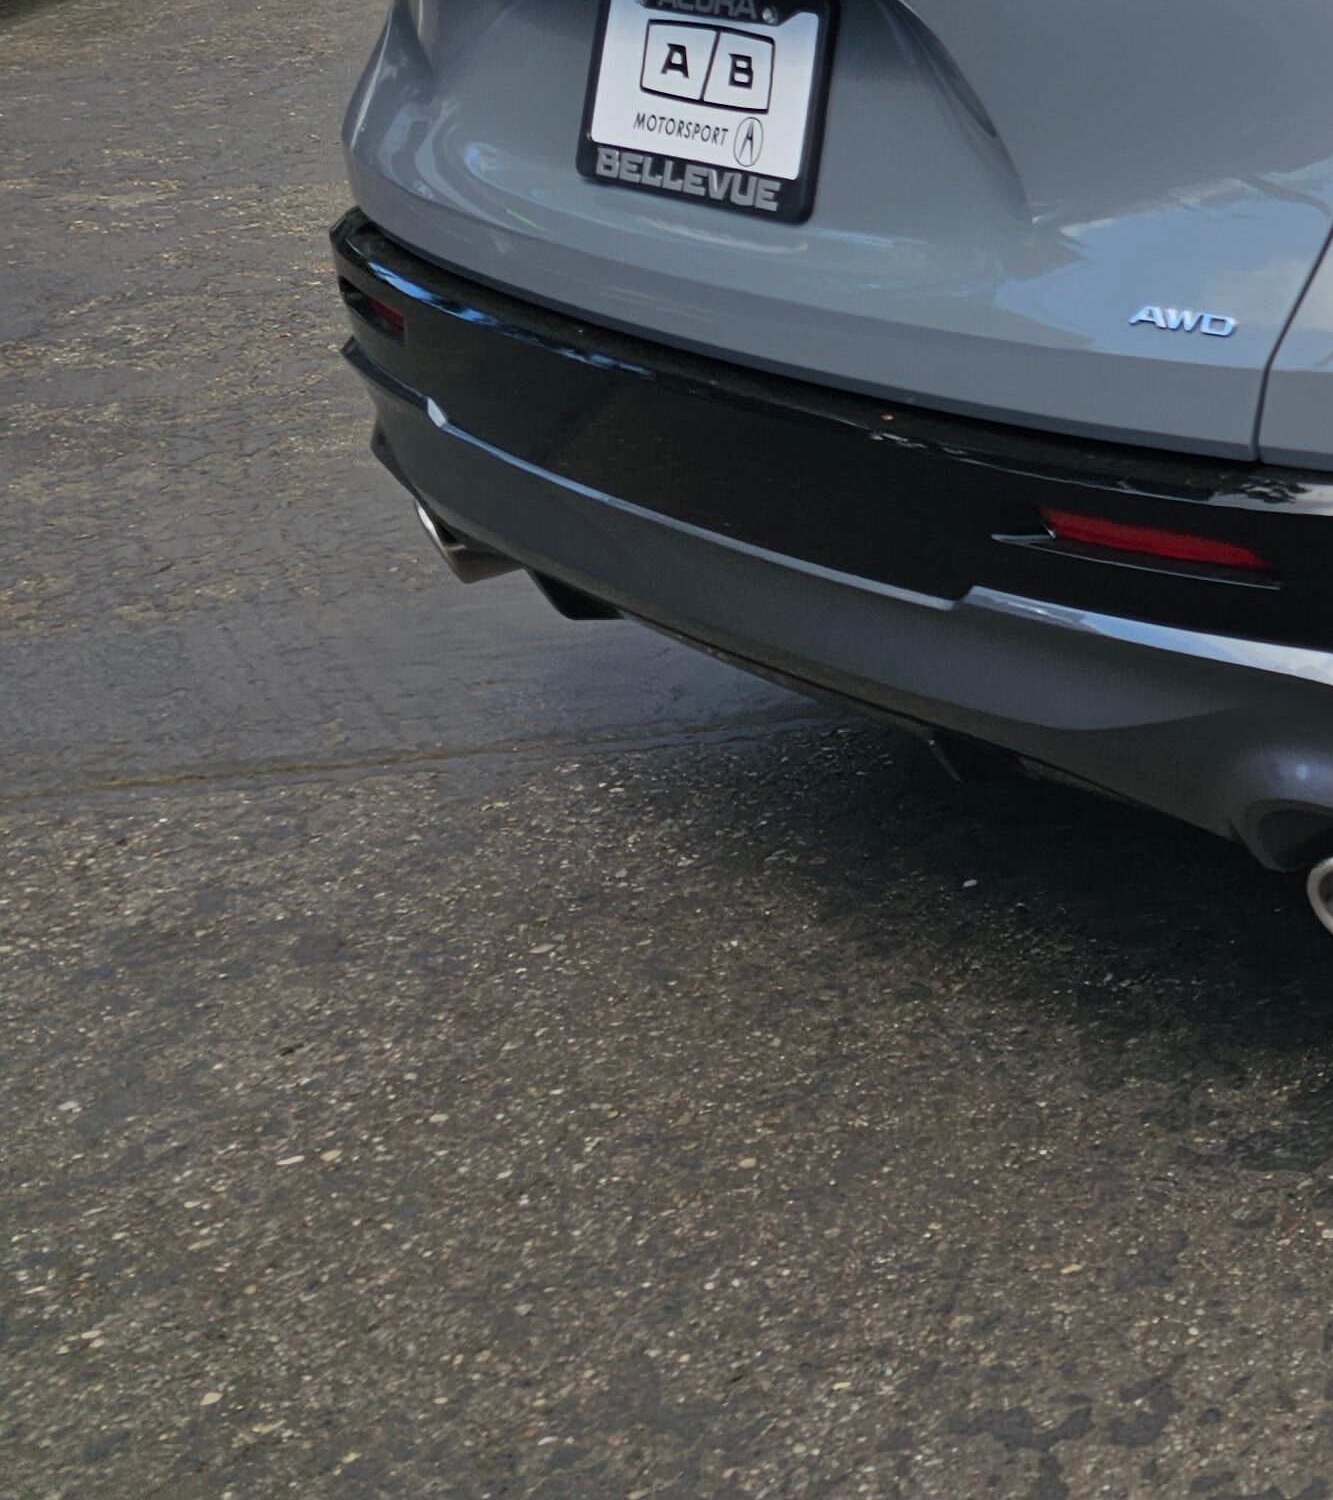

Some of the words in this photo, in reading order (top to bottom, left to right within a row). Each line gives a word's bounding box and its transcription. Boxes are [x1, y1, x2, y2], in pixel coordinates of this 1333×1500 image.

[660, 42, 690, 80] A
[727, 52, 755, 90] B
[632, 111, 730, 147] MOTORSPORT
[595, 147, 782, 212] BELLEVUE
[1127, 305, 1238, 338] AWD
